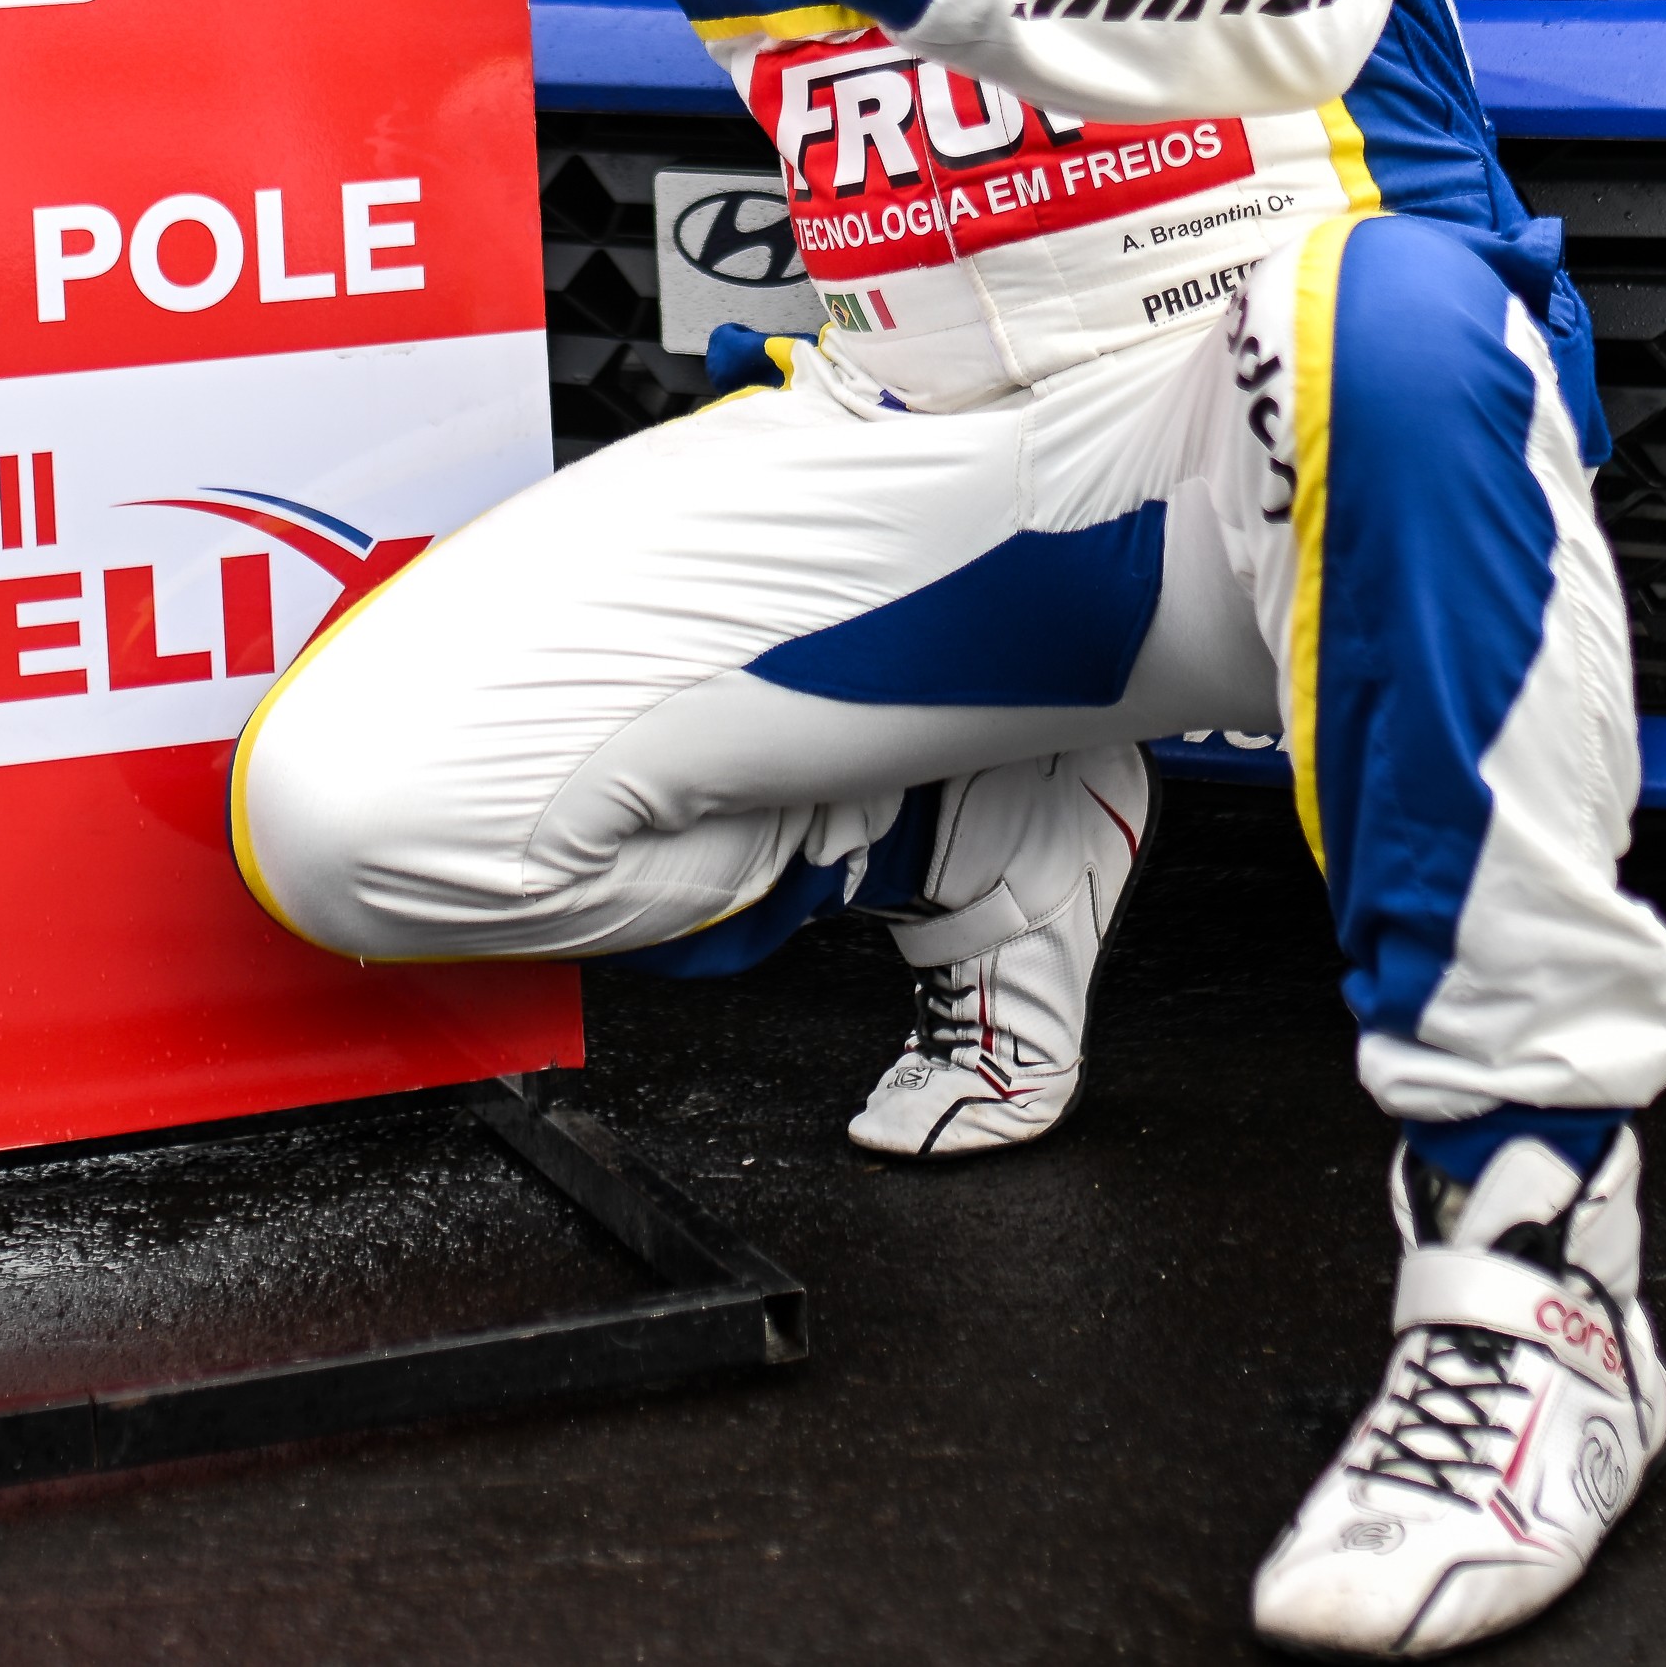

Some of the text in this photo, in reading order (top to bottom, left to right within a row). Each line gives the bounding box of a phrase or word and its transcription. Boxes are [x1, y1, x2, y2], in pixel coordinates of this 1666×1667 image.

[33, 176, 427, 324] POLE
[793, 122, 1224, 253] TECNOLOGIA EM FREIOS
[1122, 194, 1295, 254] A. Bragantini O+
